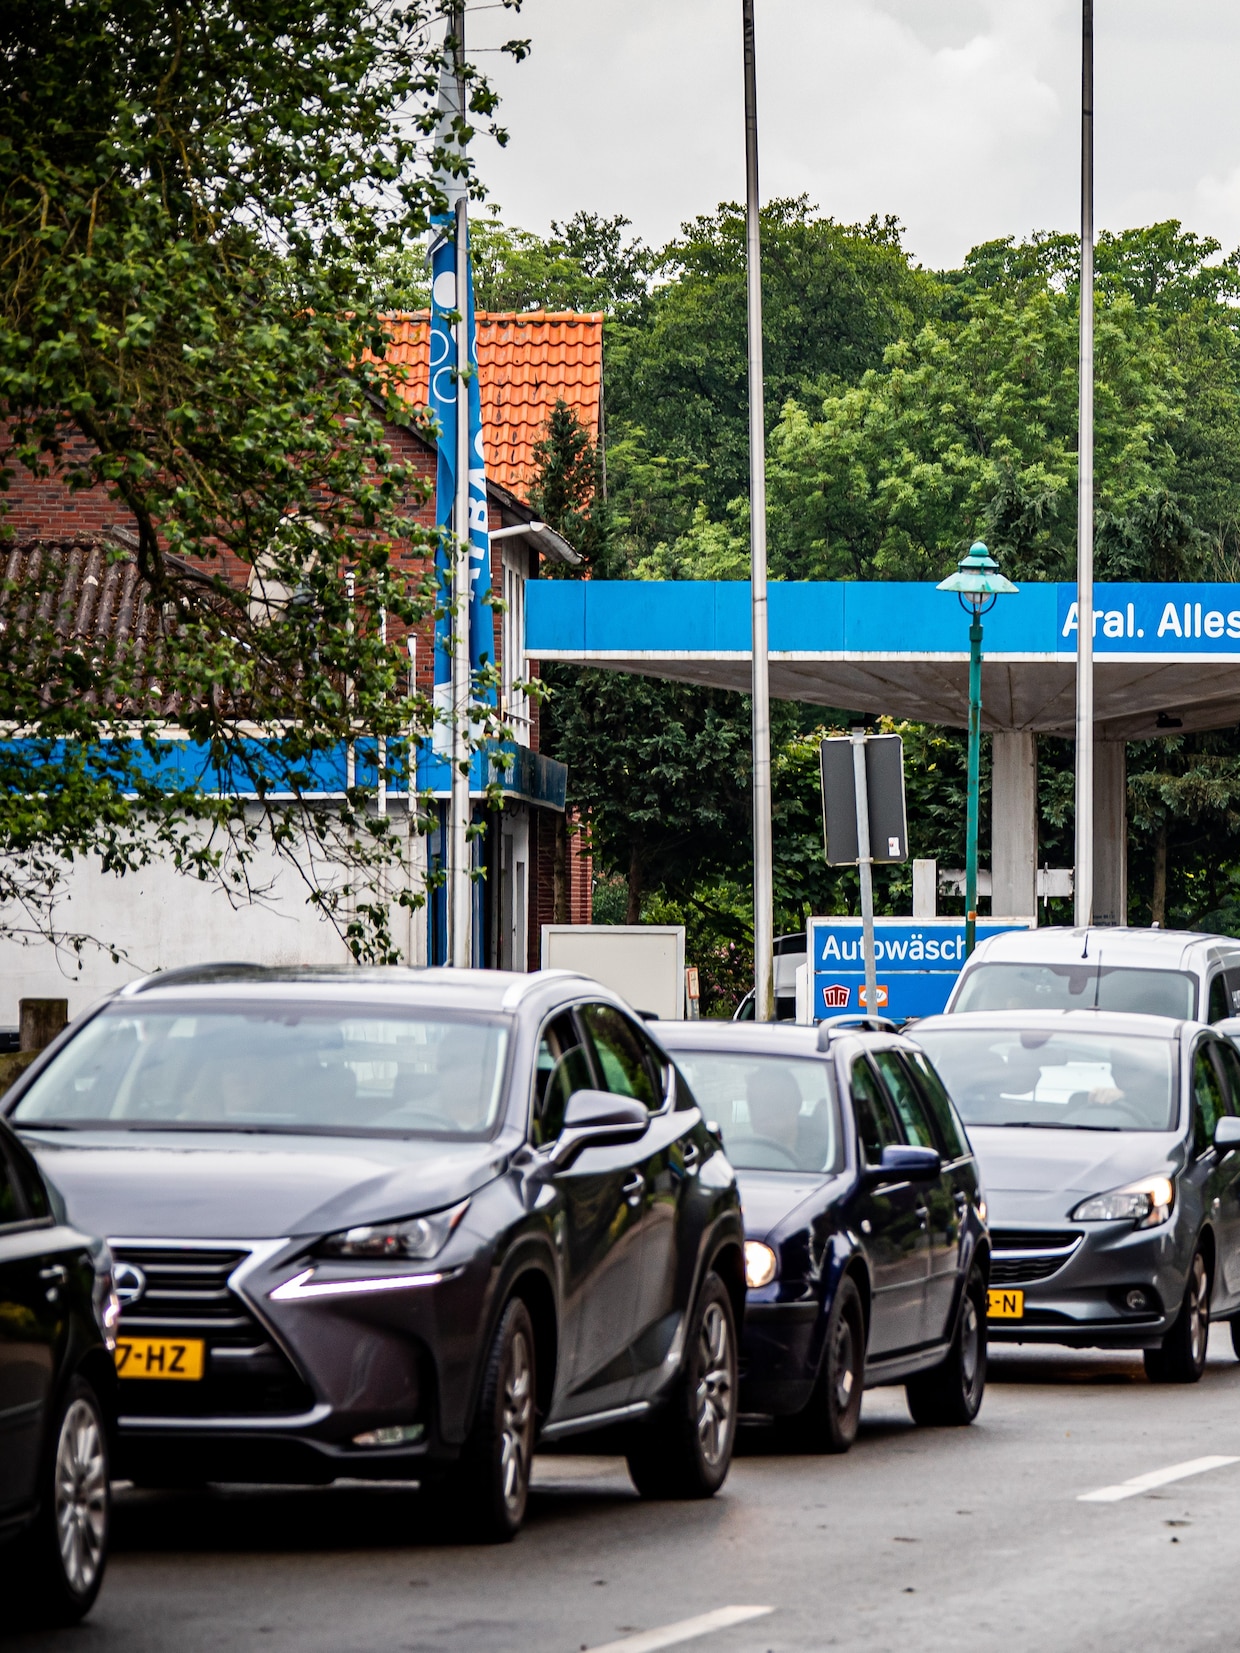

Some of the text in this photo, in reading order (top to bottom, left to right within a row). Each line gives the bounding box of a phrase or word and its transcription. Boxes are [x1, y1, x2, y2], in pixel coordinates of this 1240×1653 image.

[1062, 602, 1144, 638] Aral.
[822, 934, 982, 961] Autowäsch
[825, 986, 849, 1006] UTA
